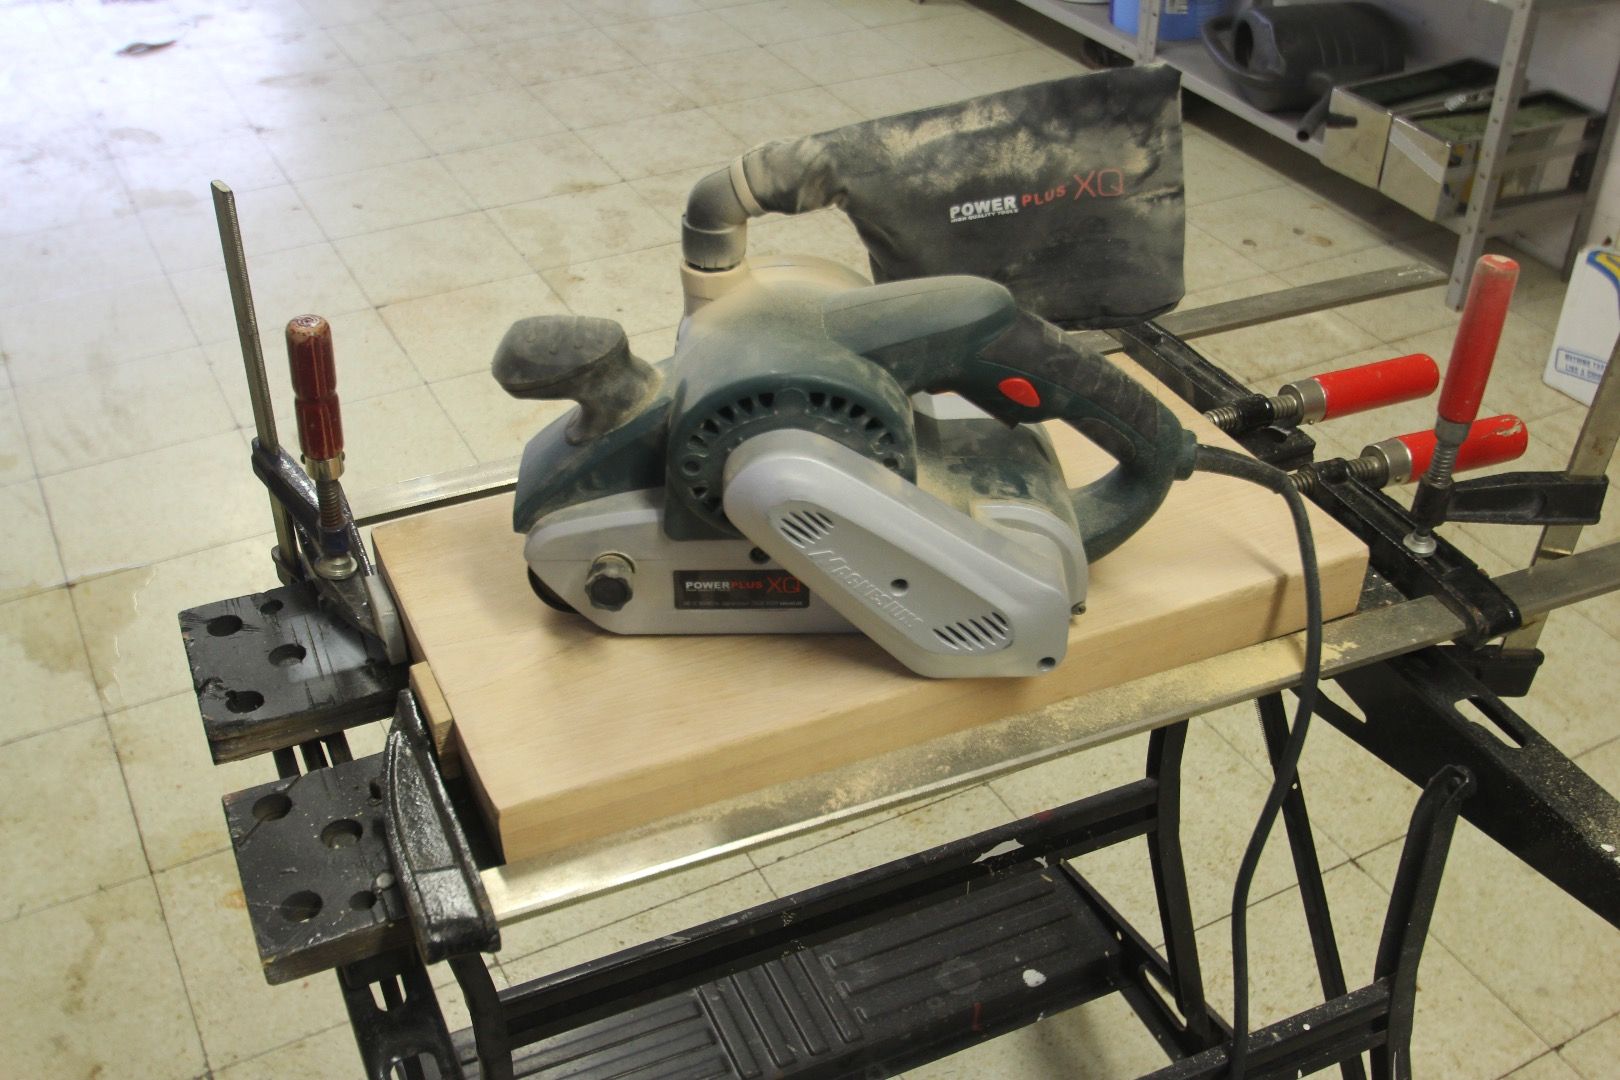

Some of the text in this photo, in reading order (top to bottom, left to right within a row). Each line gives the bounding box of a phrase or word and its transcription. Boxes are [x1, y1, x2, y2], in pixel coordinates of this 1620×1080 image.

[949, 168, 1124, 219] POWER PLUS XQ
[767, 576, 801, 593] XQ
